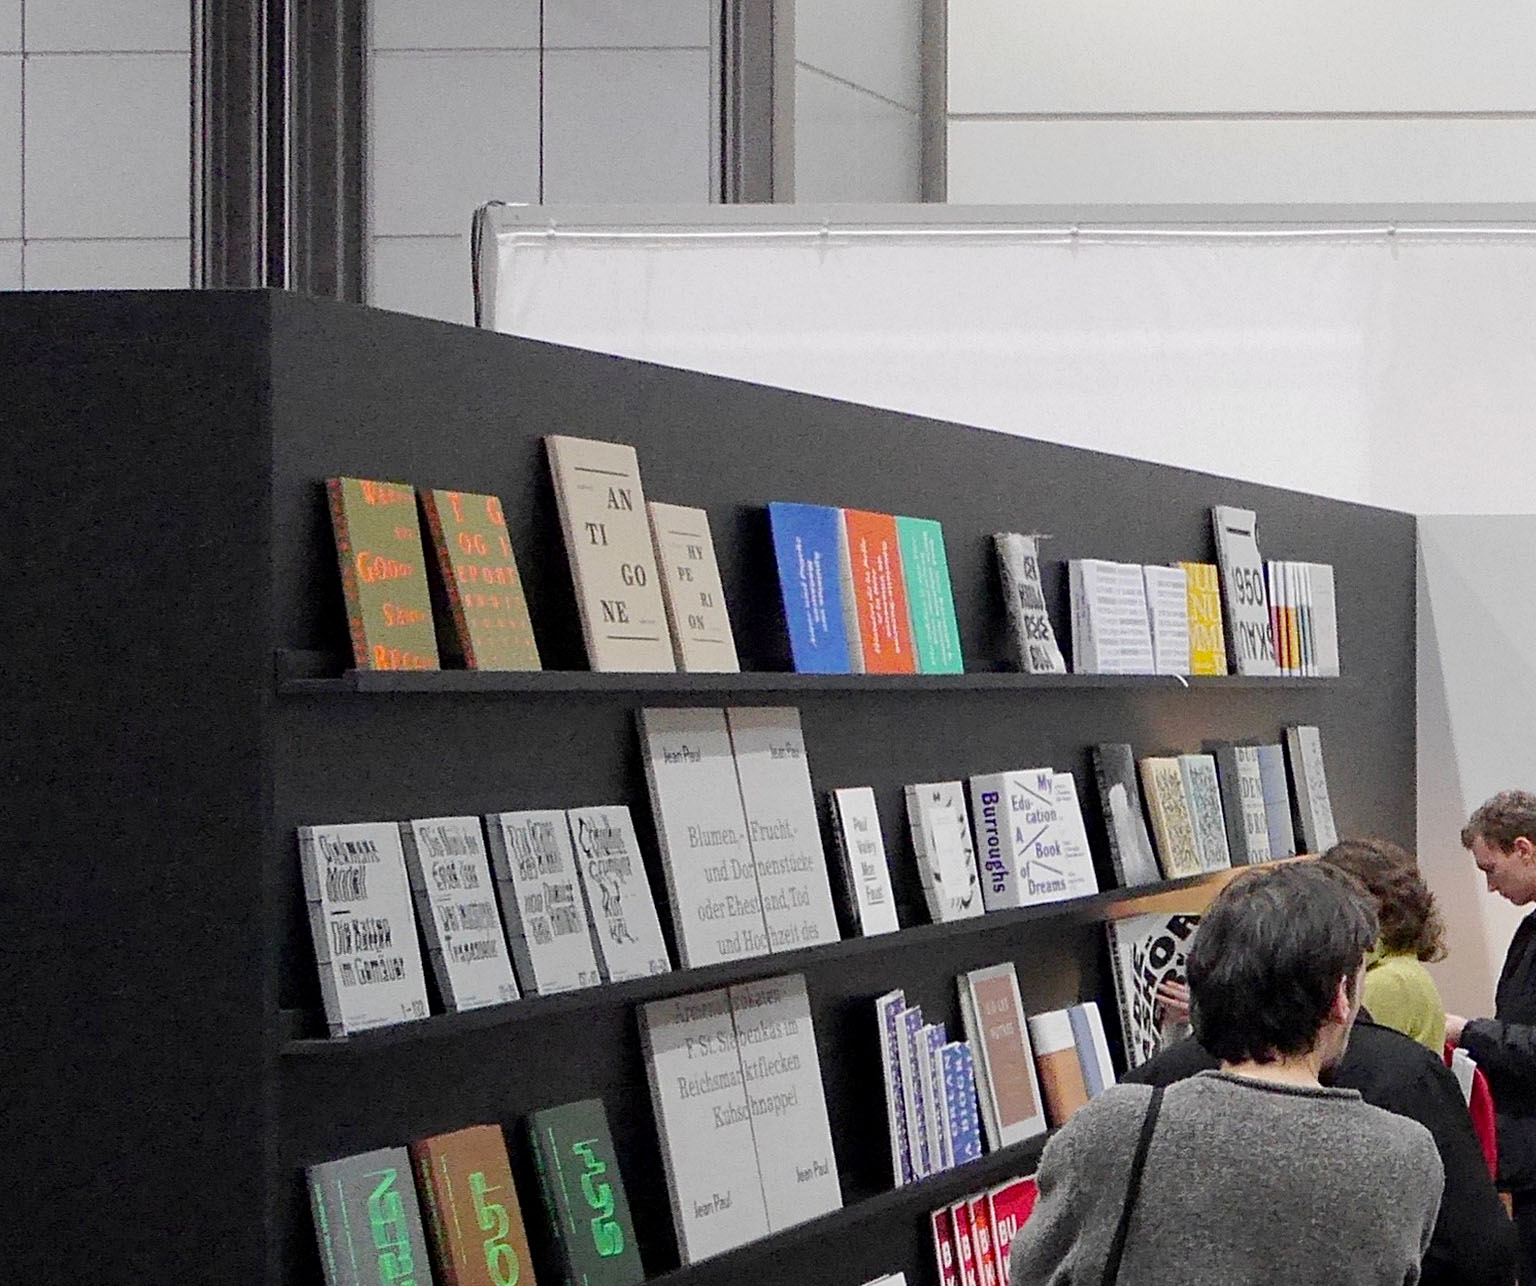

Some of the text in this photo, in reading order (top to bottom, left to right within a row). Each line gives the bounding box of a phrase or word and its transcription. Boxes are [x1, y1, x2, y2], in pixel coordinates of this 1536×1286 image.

[607, 487, 633, 511] AN
[585, 522, 608, 546] TI
[621, 563, 646, 586] GO
[677, 566, 694, 582] PE
[600, 600, 629, 624] NE
[1036, 774, 1053, 795] My
[1025, 809, 1057, 824] cation
[981, 791, 1009, 893] Burroughs
[1015, 826, 1024, 844] A
[1035, 841, 1061, 859] Book
[703, 859, 728, 883] und
[1020, 861, 1030, 879] of
[1028, 878, 1066, 896] Dreams
[697, 898, 726, 922] oder
[719, 931, 741, 955] und
[802, 923, 820, 941] des
[782, 1019, 799, 1036] im
[677, 1051, 801, 1100] Reichsmarktflecken
[711, 1084, 799, 1129] Kuhschnappel
[812, 1157, 829, 1178] Paul
